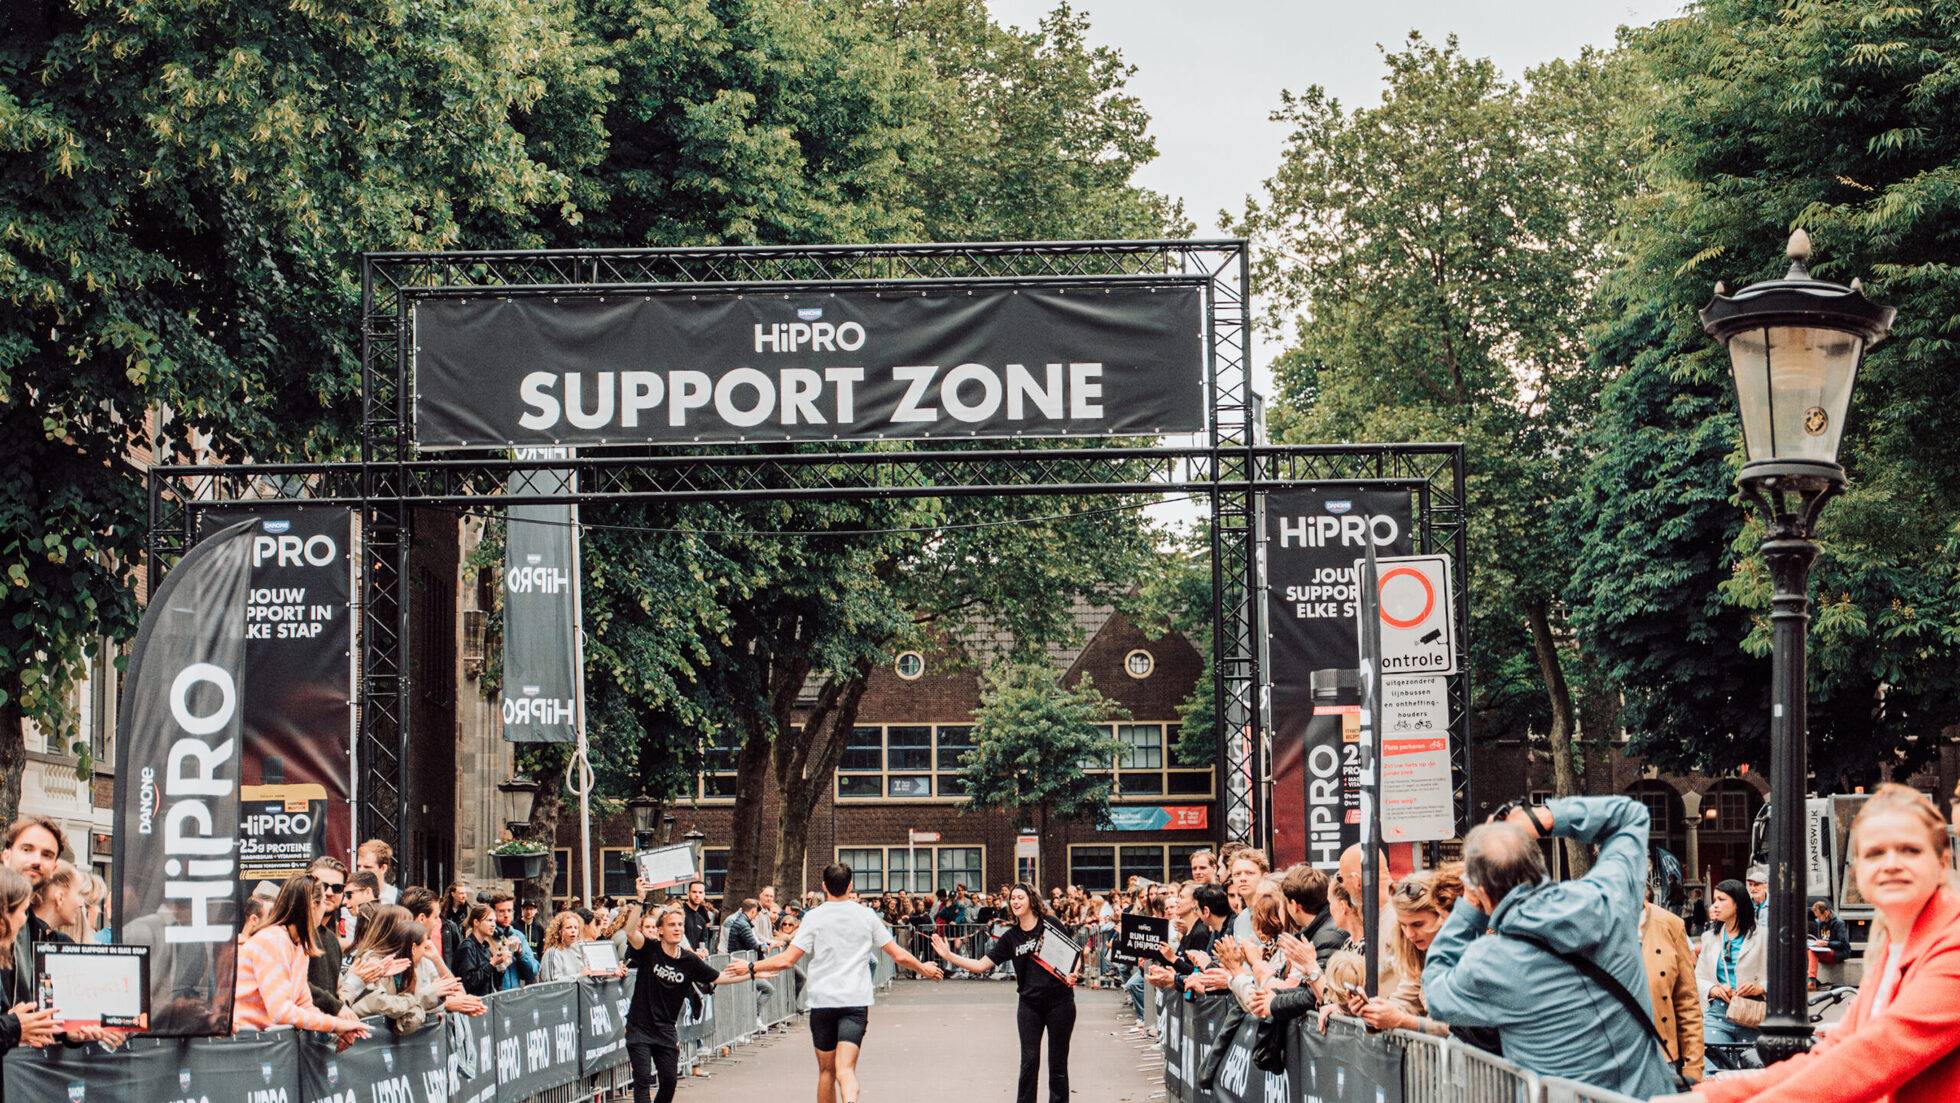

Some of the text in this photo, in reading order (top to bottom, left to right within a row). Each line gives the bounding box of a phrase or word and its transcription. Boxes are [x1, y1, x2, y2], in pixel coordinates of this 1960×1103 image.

[753, 321, 866, 353] HiPRO
[517, 362, 1105, 430] SUPPORT ZONE
[1279, 514, 1399, 548] HiPRO
[252, 534, 337, 568] PRO
[247, 588, 306, 604] JOUW
[1285, 585, 1358, 602] SUPPOR
[246, 605, 332, 622] PPORT IN
[1296, 602, 1338, 619] ELKE
[246, 622, 323, 639] KE STAP
[1381, 653, 1444, 668] ontrole
[1386, 678, 1435, 687] uitgezonderd
[1391, 689, 1431, 698] lijnbussen
[138, 766, 154, 834] DANONE
[164, 662, 237, 944] HiPRO
[1308, 744, 1342, 871] HiPRO
[266, 842, 312, 853] PROTEINE
[1811, 810, 1819, 872] HANSWIJK
[1127, 940, 1133, 948] A
[1129, 932, 1160, 943] RUN LIKE
[81, 946, 109, 954] SUPPORT
[132, 947, 147, 955] STAP
[653, 964, 685, 984] HiPRO
